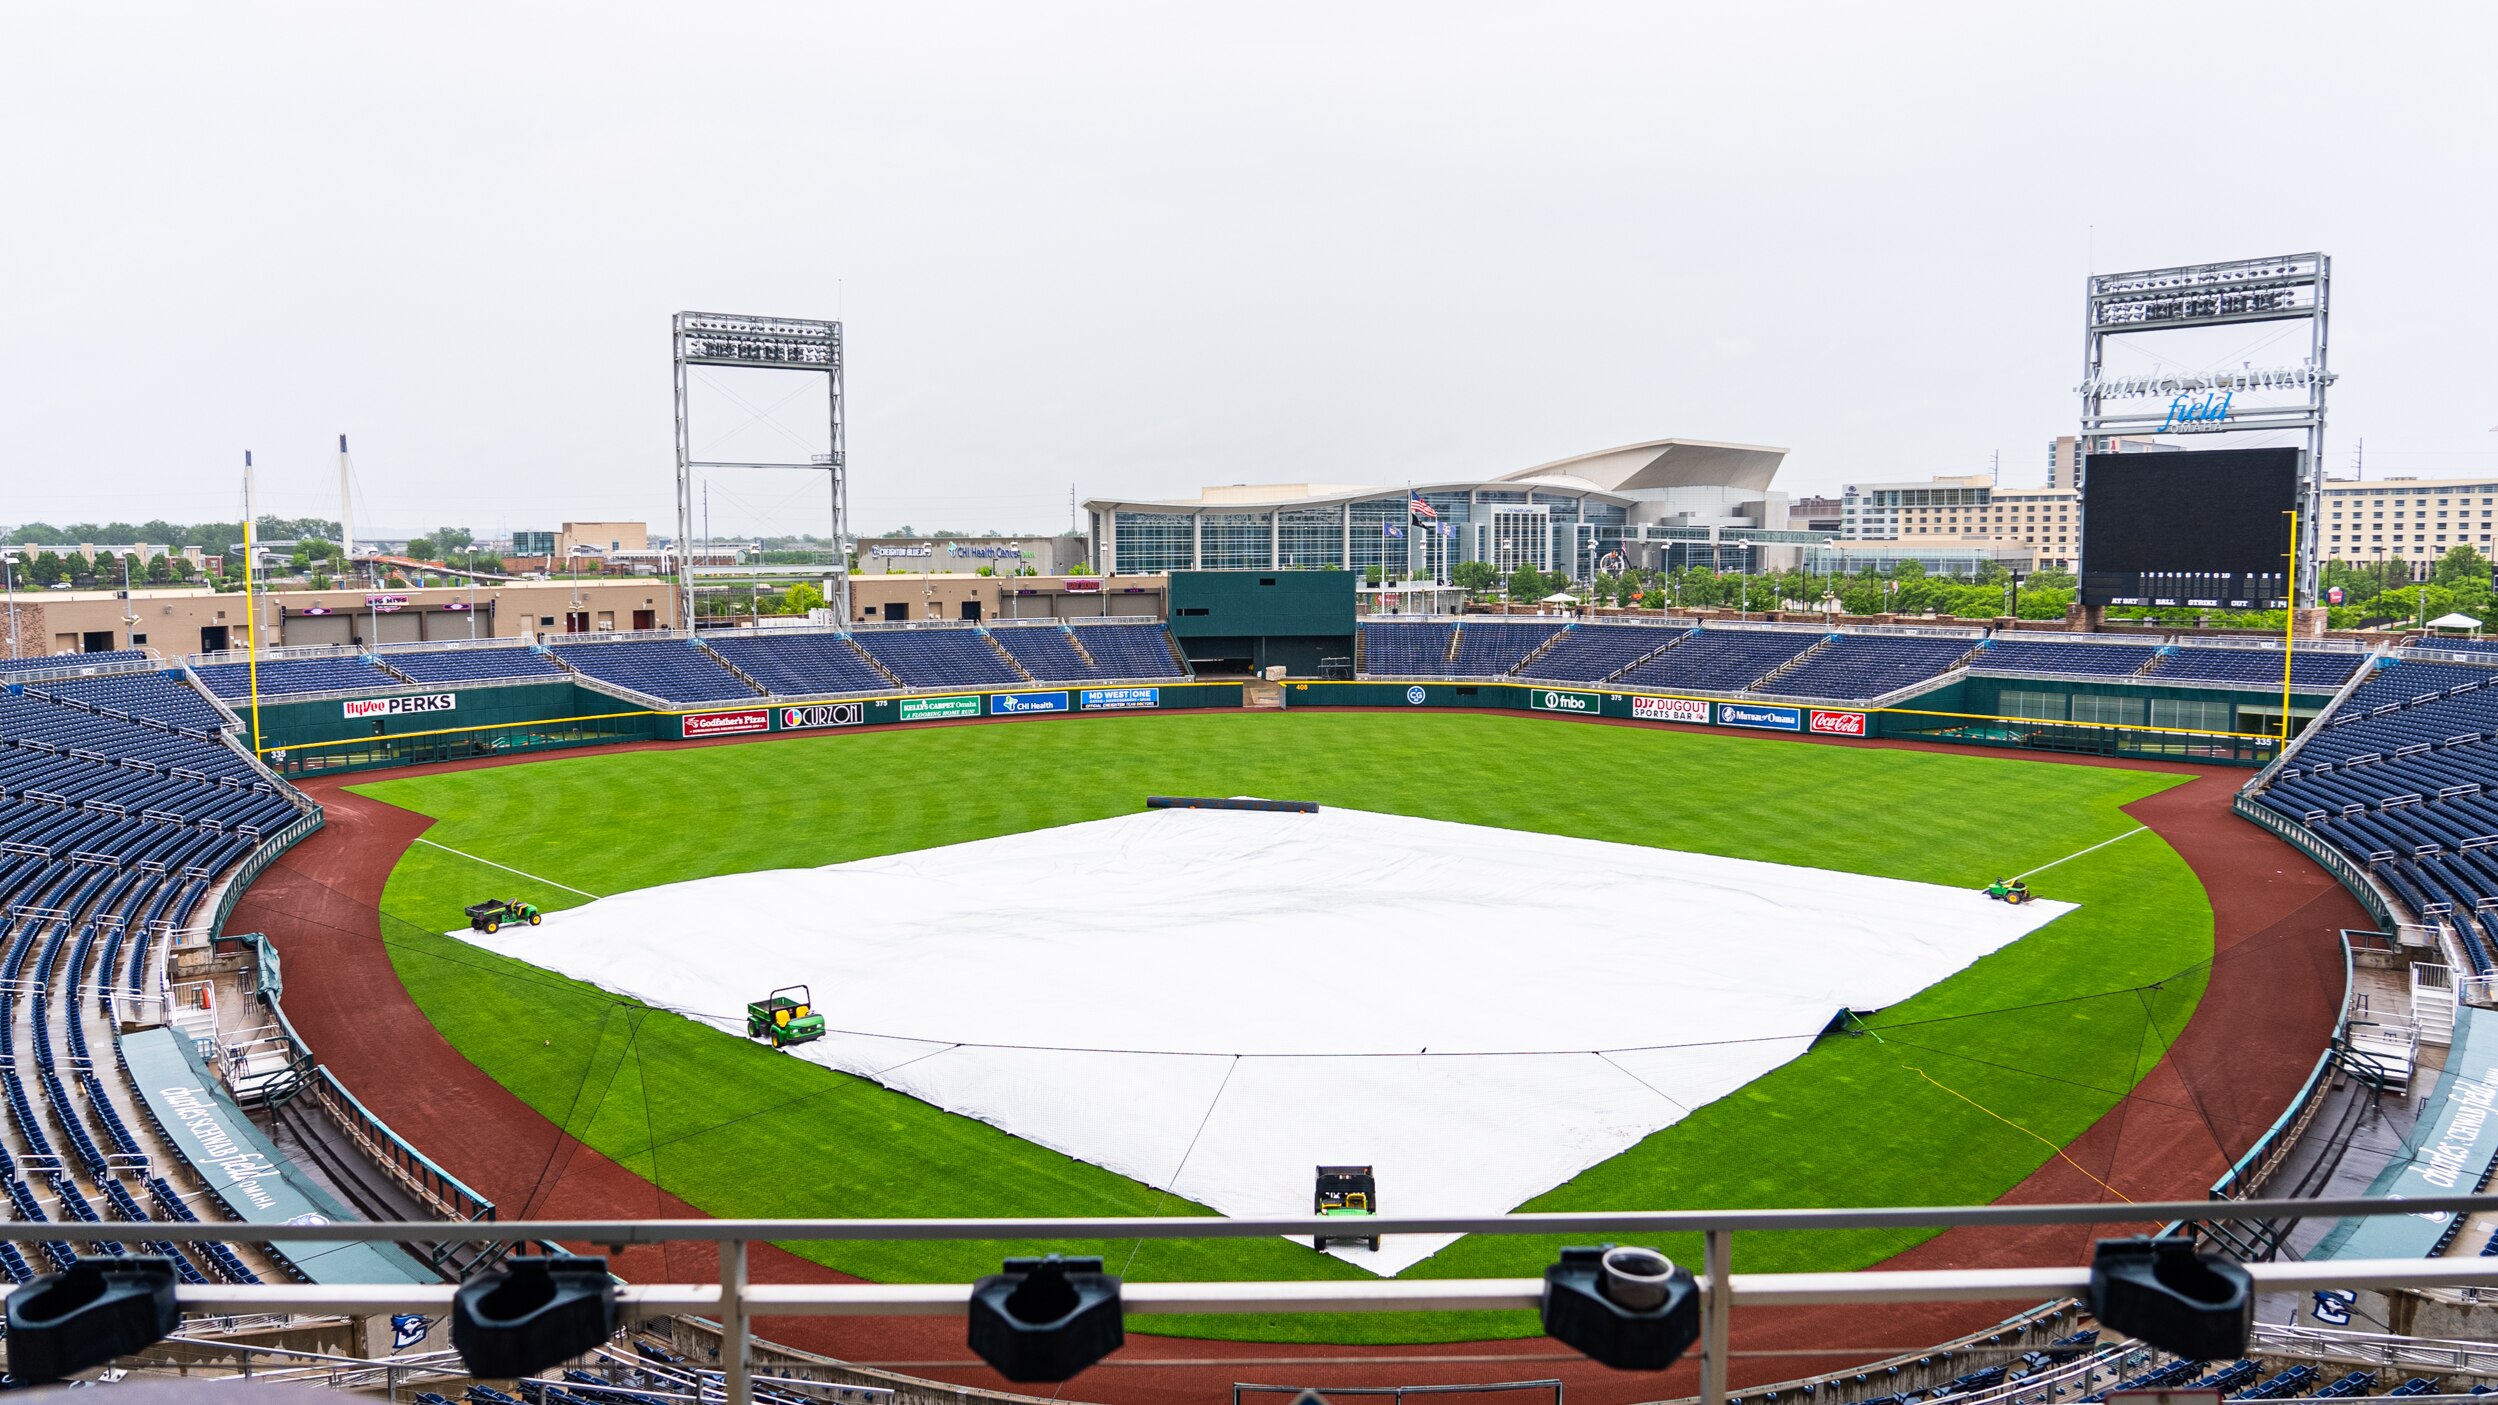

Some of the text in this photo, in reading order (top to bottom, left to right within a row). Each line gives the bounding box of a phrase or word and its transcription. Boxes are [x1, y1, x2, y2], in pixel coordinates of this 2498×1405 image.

[2195, 364, 2322, 393] SCHWAB
[2157, 391, 2232, 432] field
[2170, 422, 2223, 434] OMAHA
[957, 547, 970, 557] CHI
[971, 546, 995, 558] Health
[1089, 692, 1103, 700] MD
[1104, 690, 1129, 698] WEST
[389, 695, 451, 713] PERKS
[929, 702, 955, 710] CARPET
[1031, 701, 1054, 709] Health
[1560, 695, 1585, 709] fnbo
[1635, 698, 1708, 713] DJ's DUGOUT
[803, 705, 857, 725] CURZON
[1635, 708, 1669, 718] SPORTS
[1674, 712, 1692, 720] BAR
[700, 715, 766, 727] Godfather's Pizza
[1813, 712, 1862, 732] Coca-Cola
[270, 750, 286, 759] 335
[186, 1116, 239, 1157] SCHWAB
[238, 1179, 277, 1210] OMAHA
